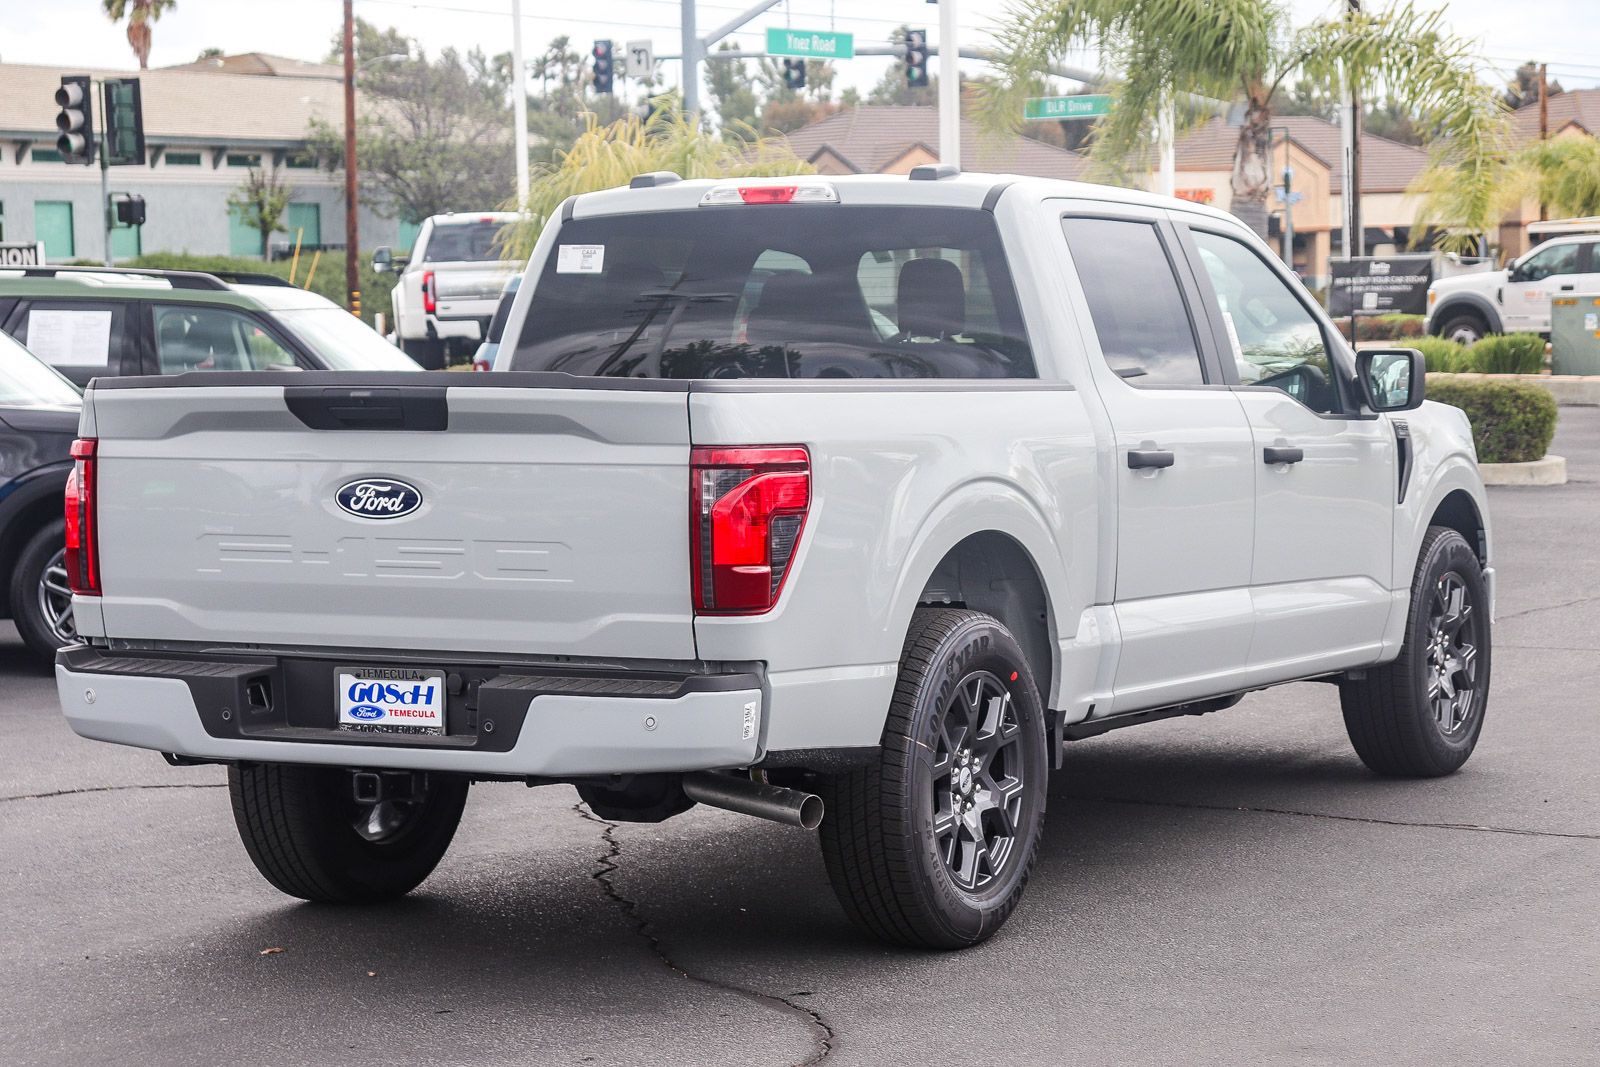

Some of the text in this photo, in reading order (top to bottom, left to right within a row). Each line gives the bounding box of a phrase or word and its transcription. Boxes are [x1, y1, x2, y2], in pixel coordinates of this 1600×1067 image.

[786, 32, 836, 53] Ynez Road
[1068, 99, 1093, 112] Drive
[0, 248, 36, 265] ION
[350, 484, 405, 511] Ford
[361, 668, 419, 680] TEMECULA
[388, 709, 436, 718] TEMECULA
